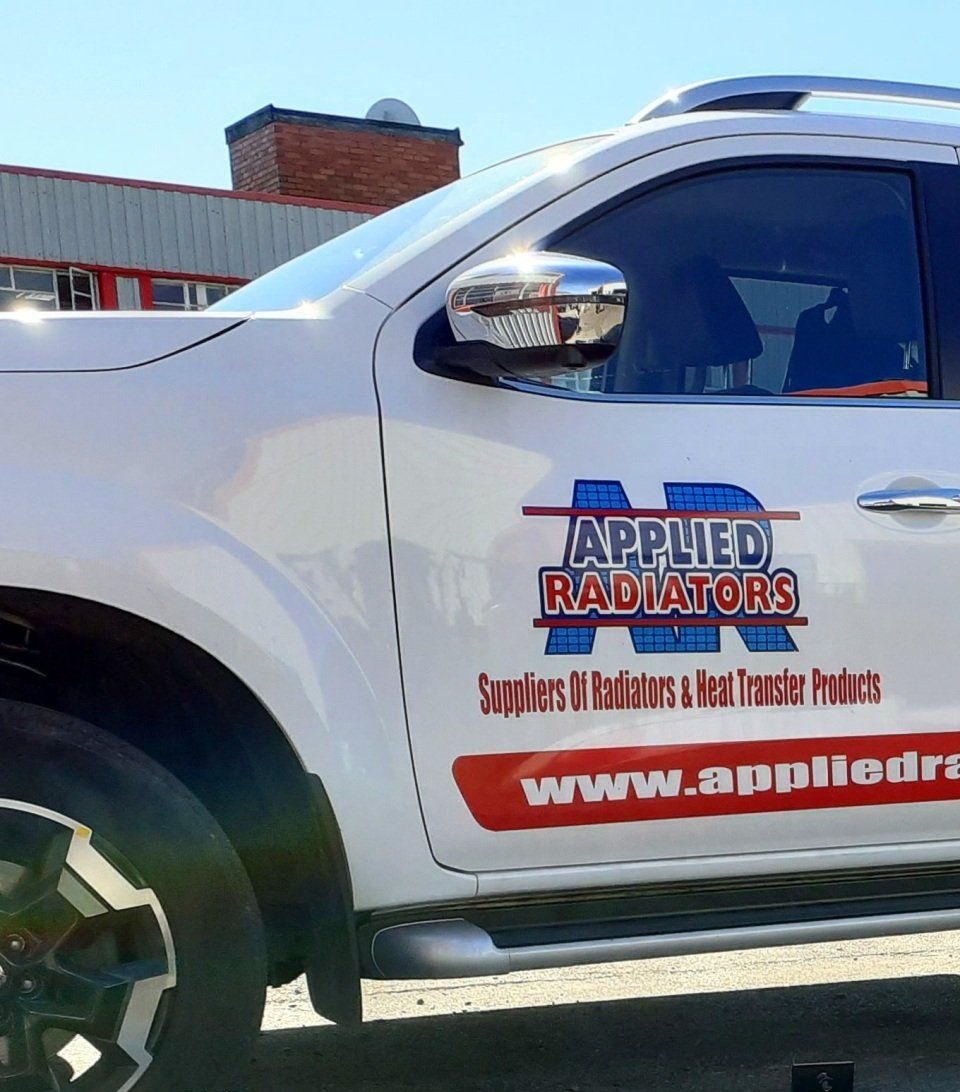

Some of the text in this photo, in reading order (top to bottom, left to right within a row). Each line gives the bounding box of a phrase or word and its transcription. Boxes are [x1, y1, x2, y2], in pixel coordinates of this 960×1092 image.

[569, 516, 767, 569] APPLIED
[543, 571, 796, 616] RADIATORS
[478, 668, 881, 718] Suppliers Of Radiators & Heat Transfer Products
